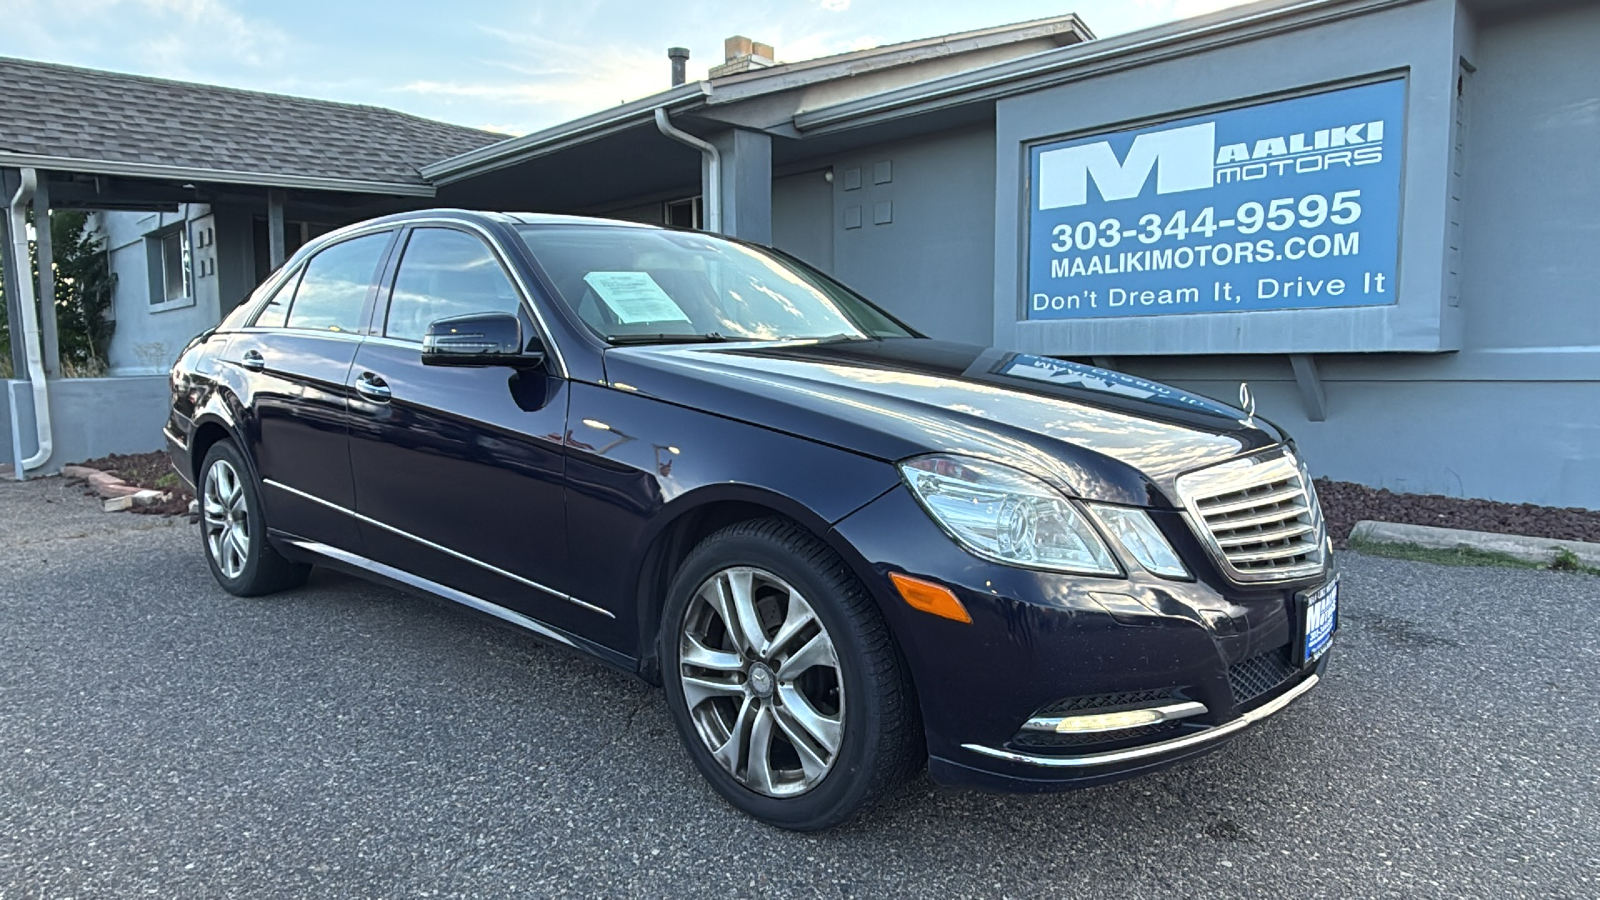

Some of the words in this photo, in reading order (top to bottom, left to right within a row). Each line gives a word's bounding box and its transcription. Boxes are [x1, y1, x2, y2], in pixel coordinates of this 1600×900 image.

[1216, 146, 1383, 184] MOTORS
[1051, 190, 1362, 253] 303-344-9595
[1051, 232, 1360, 278] MAALIKIMOTORS.COM
[1033, 290, 1098, 311] Don't
[1109, 287, 1199, 307] Dream
[1214, 281, 1241, 304] It,
[1257, 276, 1346, 299] Drive
[1363, 272, 1386, 294] It
